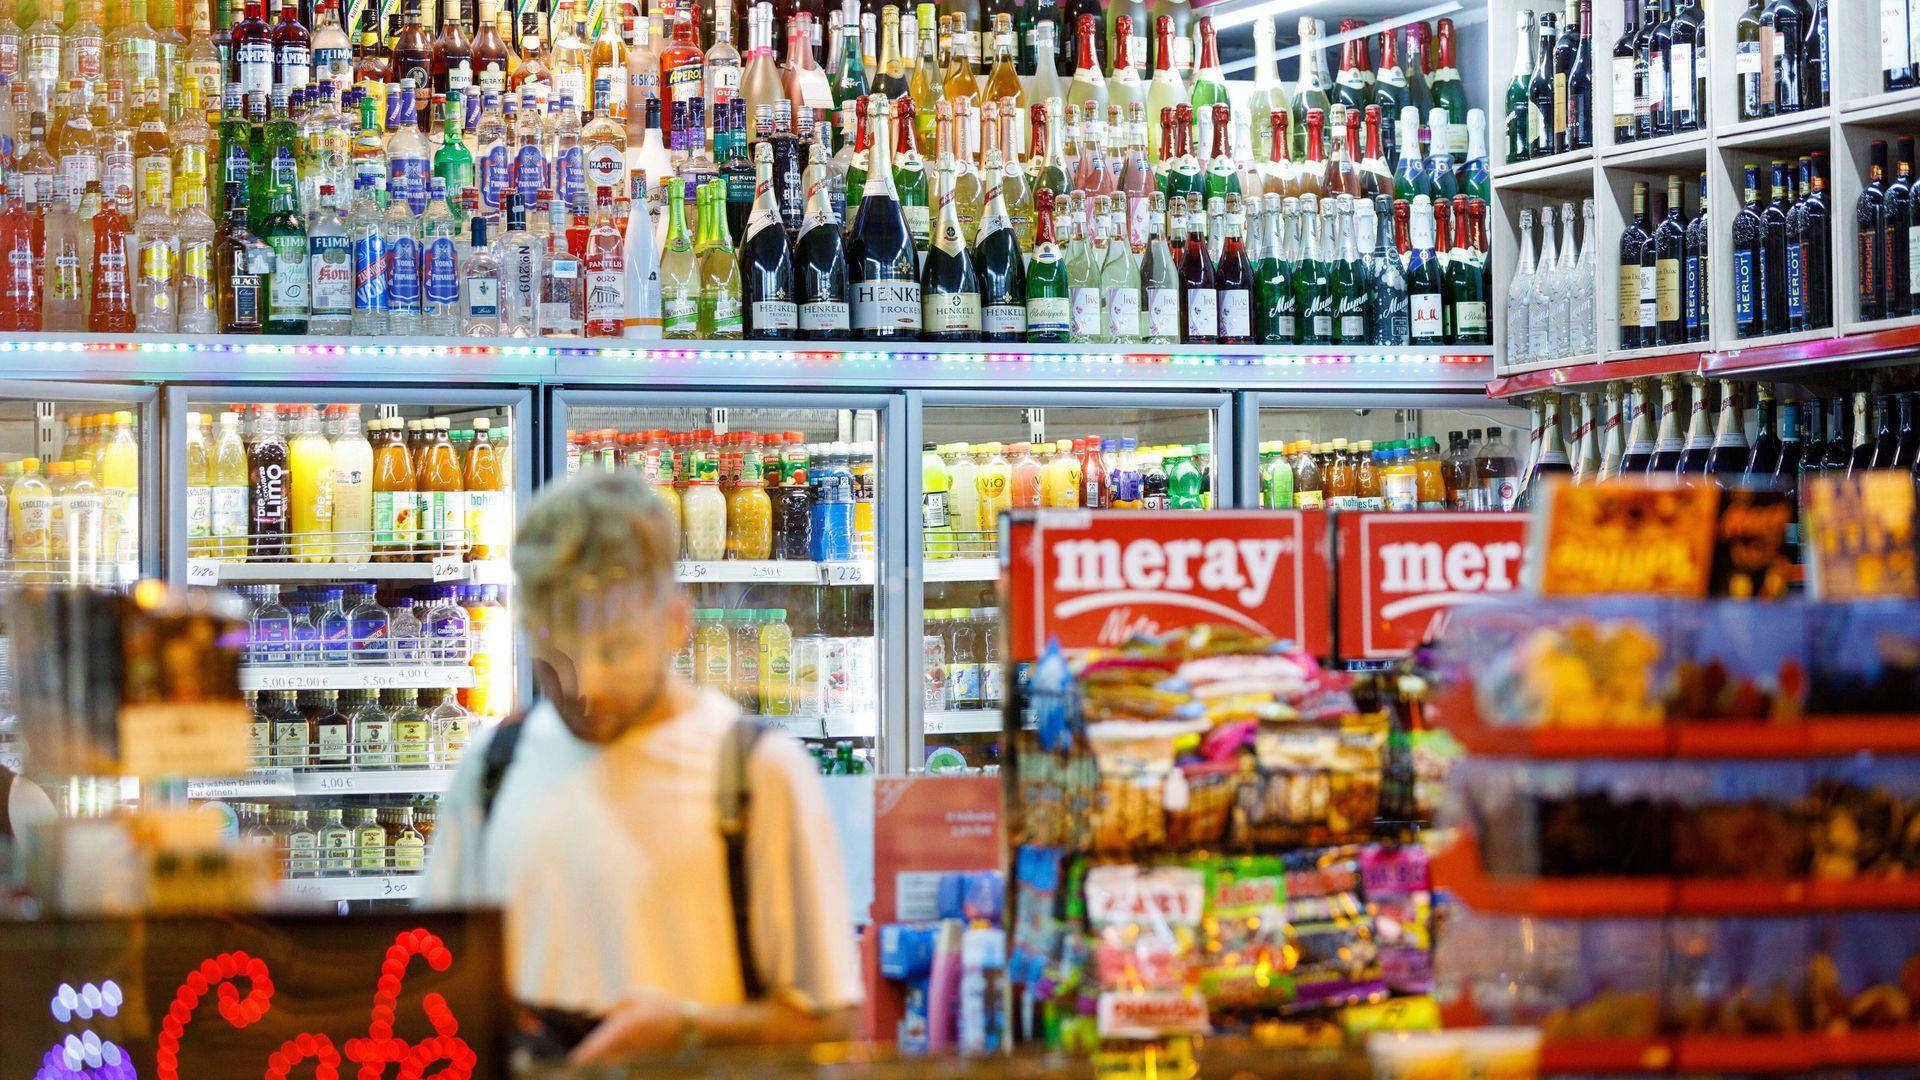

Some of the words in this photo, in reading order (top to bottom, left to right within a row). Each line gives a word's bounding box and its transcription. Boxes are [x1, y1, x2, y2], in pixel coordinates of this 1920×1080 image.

[669, 69, 703, 84] APEROL
[590, 161, 622, 169] MARTINI
[589, 260, 623, 268] PANTELIS
[1865, 236, 1873, 294] GRENACHE
[317, 265, 349, 285] Korn
[1791, 251, 1800, 306] MERLOT
[232, 277, 260, 287] BLACK
[1741, 257, 1750, 313] MERLOT
[804, 305, 846, 314] HENKELL
[1334, 293, 1368, 318] Mumm
[936, 307, 975, 316] HENKELL
[986, 308, 1025, 317] HENKELL
[982, 477, 1004, 488] ViO
[266, 463, 283, 517] Limo
[1053, 537, 1281, 607] meray
[263, 778, 277, 786] die
[346, 778, 352, 788] €
